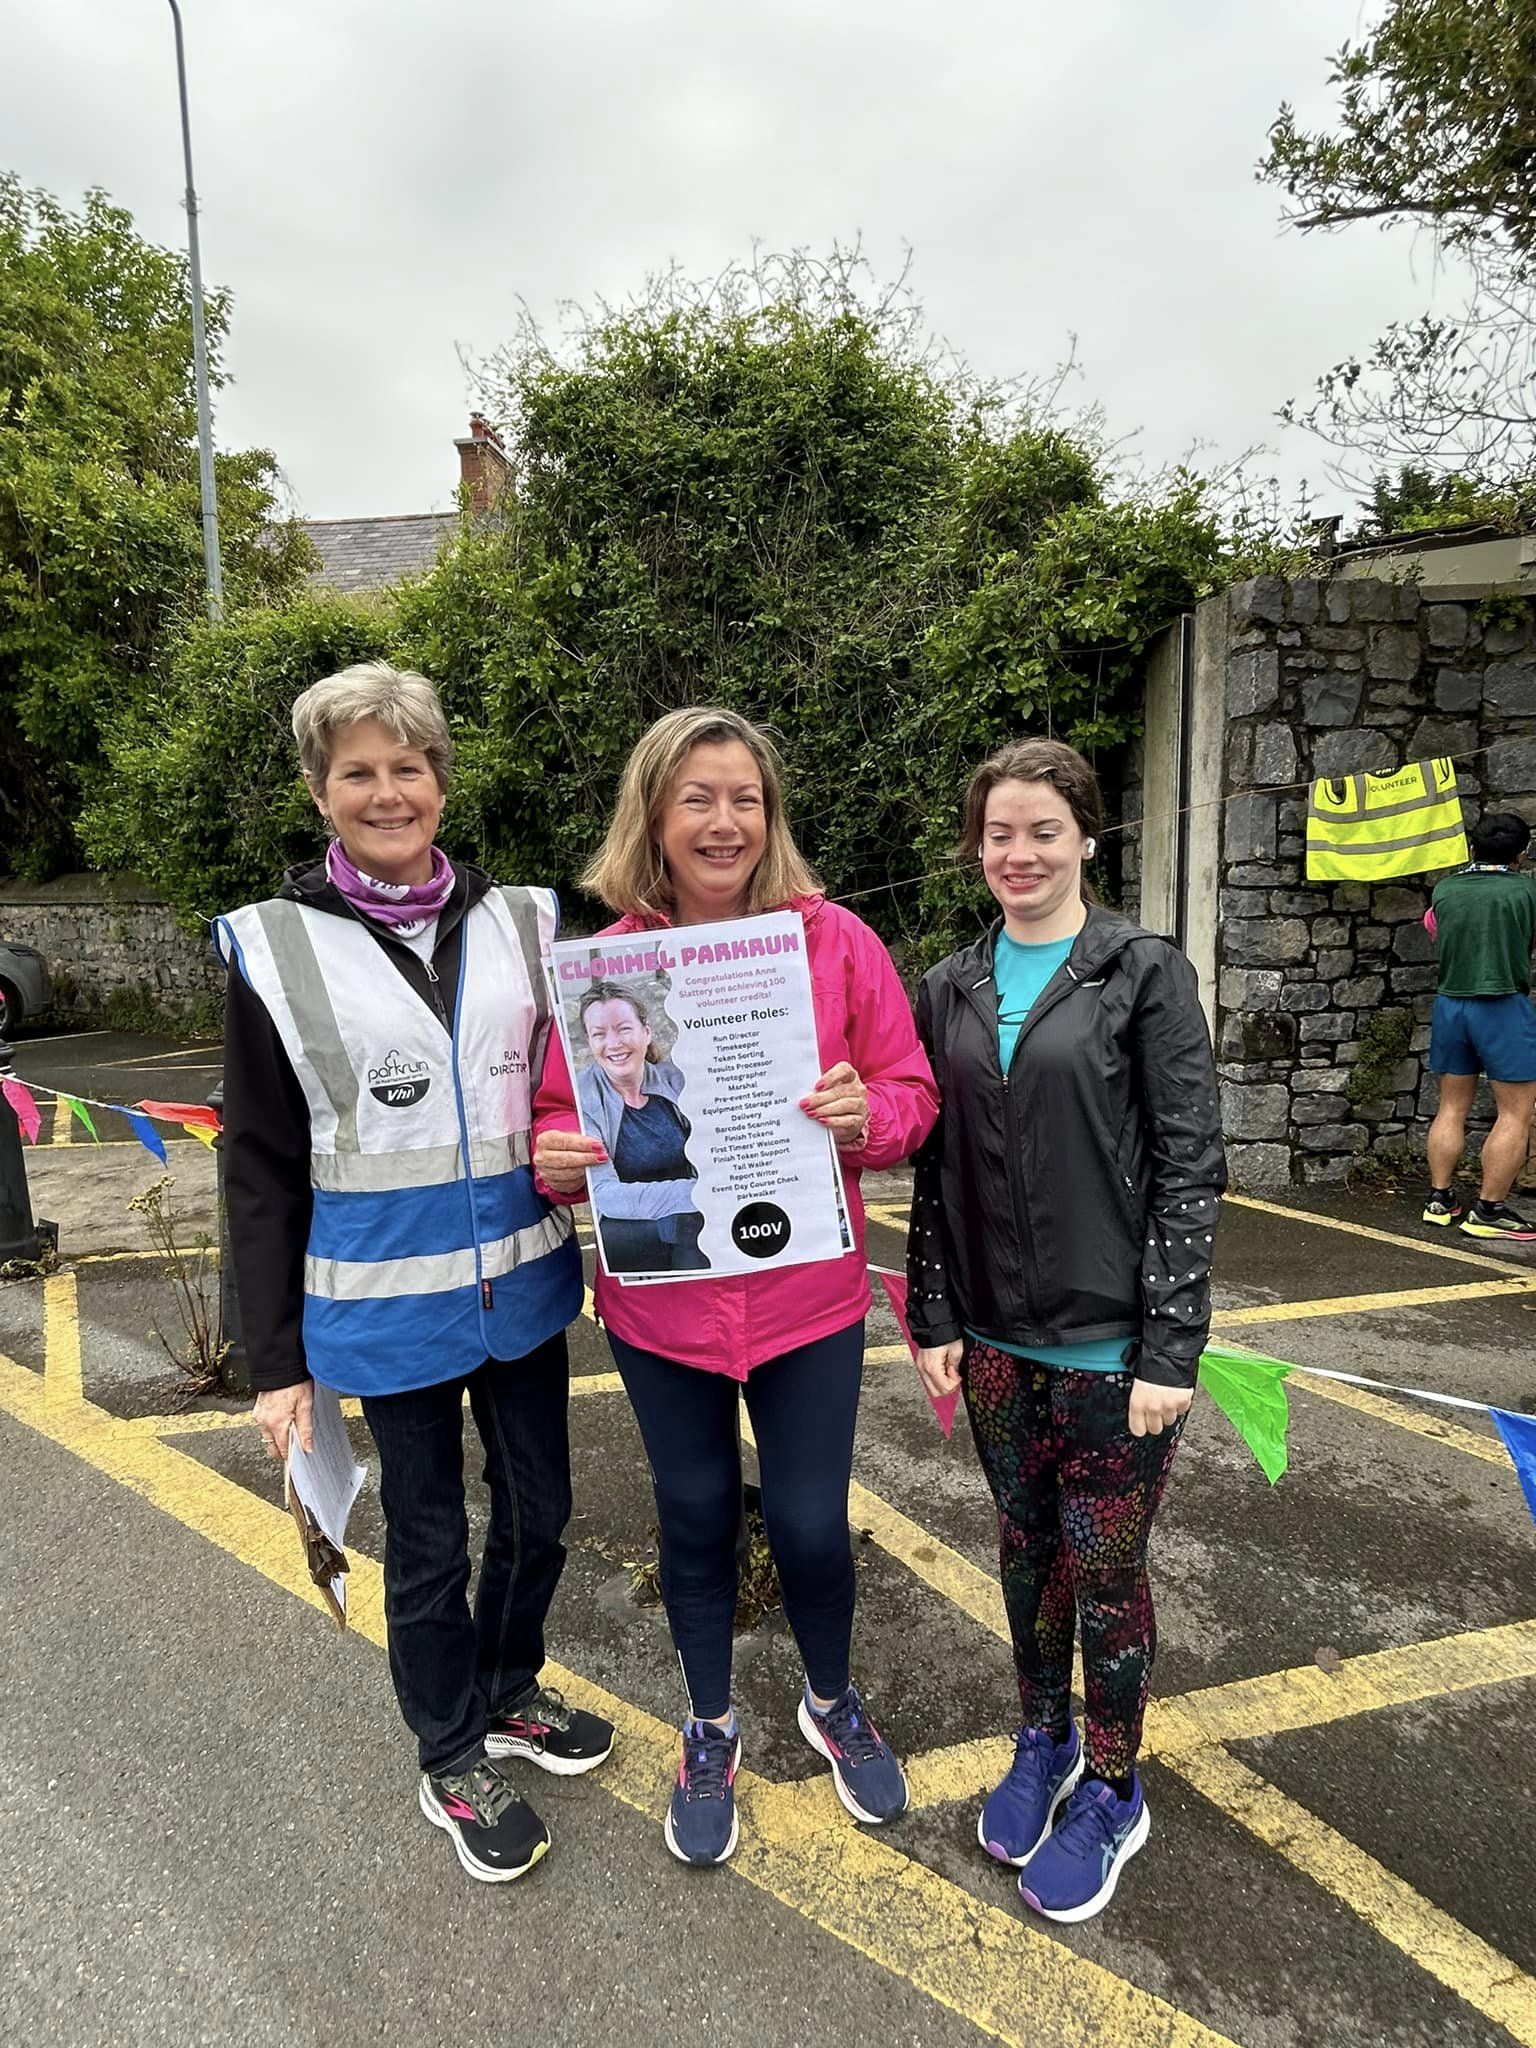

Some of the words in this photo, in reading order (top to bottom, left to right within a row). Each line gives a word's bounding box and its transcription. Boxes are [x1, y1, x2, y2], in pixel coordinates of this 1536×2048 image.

[1370, 776, 1417, 792] OLUNTEER
[559, 949, 677, 981] CLONMEL
[681, 933, 799, 967] PARKRUN
[685, 971, 753, 985] Congratulations
[679, 987, 713, 998] Slattery
[715, 986, 726, 994] on
[728, 980, 768, 992] achieving
[769, 977, 786, 986] 100
[696, 995, 738, 1008] volunteer
[684, 1013, 748, 1030] Volunteer
[751, 1007, 789, 1021] Roles:
[713, 1035, 728, 1043] Run
[729, 1031, 760, 1041] Director
[716, 1041, 760, 1052] Timekeeper
[713, 1054, 737, 1063] Token
[737, 1050, 765, 1060] Sorting
[368, 1050, 430, 1083] parkrun
[707, 1064, 735, 1074] Results
[736, 1060, 773, 1070] Processor
[716, 1070, 767, 1083] Photographer
[728, 1081, 758, 1091] Marshal
[714, 1092, 750, 1103] Pre-event
[752, 1090, 774, 1099] Setup
[703, 1104, 743, 1115] Equipment
[744, 1100, 772, 1110] Storage
[774, 1097, 788, 1105] and
[731, 1112, 762, 1122] Delivery
[715, 1124, 746, 1134] Barcode
[747, 1119, 781, 1130] Scanning
[725, 1133, 747, 1142] Finish
[747, 1130, 774, 1139] Tokens
[710, 1145, 727, 1154] First
[756, 1138, 790, 1148] Welcome
[713, 1155, 736, 1164] Finish
[736, 1151, 759, 1160] Token
[760, 1147, 790, 1158] Support
[733, 1163, 746, 1171] Tail
[748, 1160, 773, 1169] Walker
[729, 1172, 754, 1182] Report
[756, 1169, 778, 1178] Writer
[712, 1185, 733, 1193] Event
[734, 1183, 748, 1191] Day
[750, 1180, 775, 1189] Course
[776, 1175, 799, 1184] Check
[737, 1189, 776, 1201] parkwalker
[739, 1221, 783, 1240] 100V
